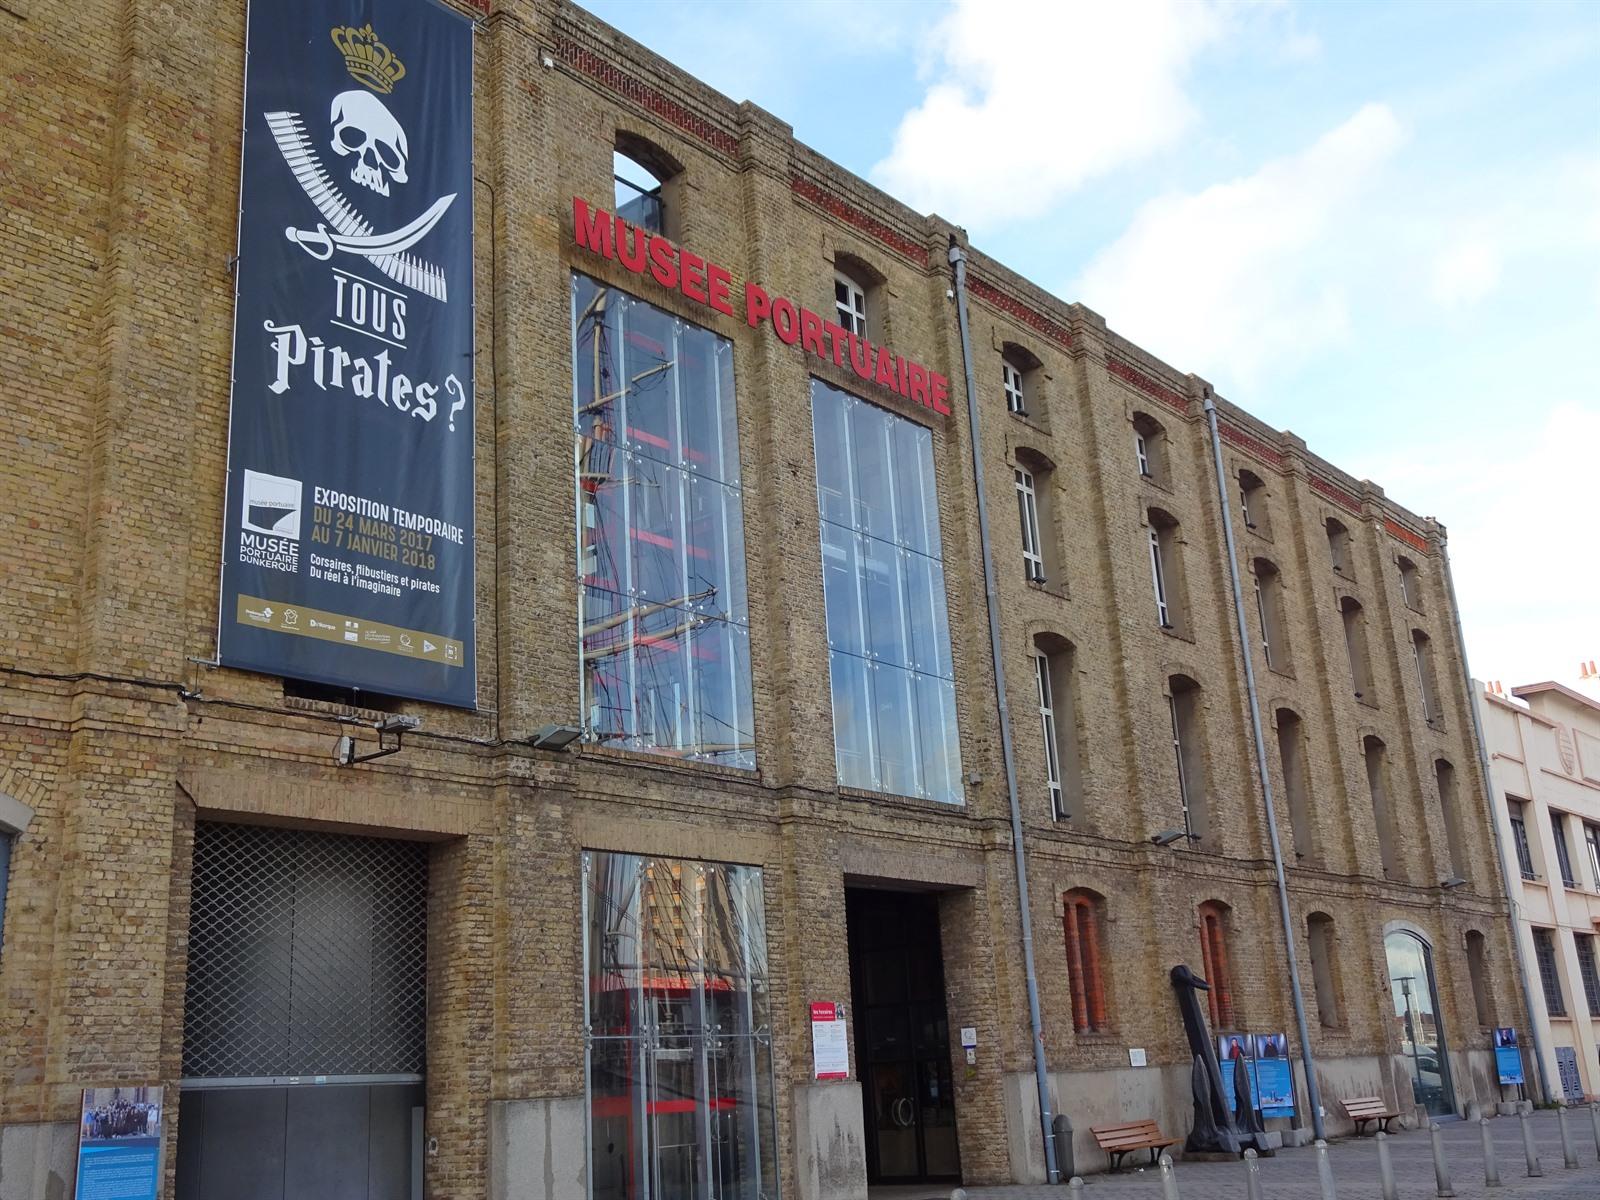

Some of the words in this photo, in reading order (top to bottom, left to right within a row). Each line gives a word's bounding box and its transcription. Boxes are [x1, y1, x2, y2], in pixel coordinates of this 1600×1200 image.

[333, 275, 406, 340] TOUS
[572, 195, 734, 317] MUSEE
[745, 281, 951, 416] PORTUAIRE
[313, 506, 332, 525] DU
[336, 512, 354, 530] 24
[359, 517, 396, 542] MARS
[400, 530, 432, 551] 2017
[314, 486, 389, 522] EXPOSITION
[392, 507, 464, 545] TEMPORAIRE
[240, 546, 298, 565] PORTUAIRE
[241, 531, 299, 556] MUSÉE
[311, 525, 330, 544] AU
[335, 530, 343, 547] 7
[347, 533, 398, 561] JANVIER
[402, 550, 435, 570] 2018
[240, 554, 298, 573] DUNKERQUE
[310, 566, 321, 579] Du
[324, 568, 341, 583] réel
[343, 571, 348, 585] à
[351, 576, 401, 597] l'imaginaire
[401, 576, 409, 587] et
[411, 579, 440, 594] pirates
